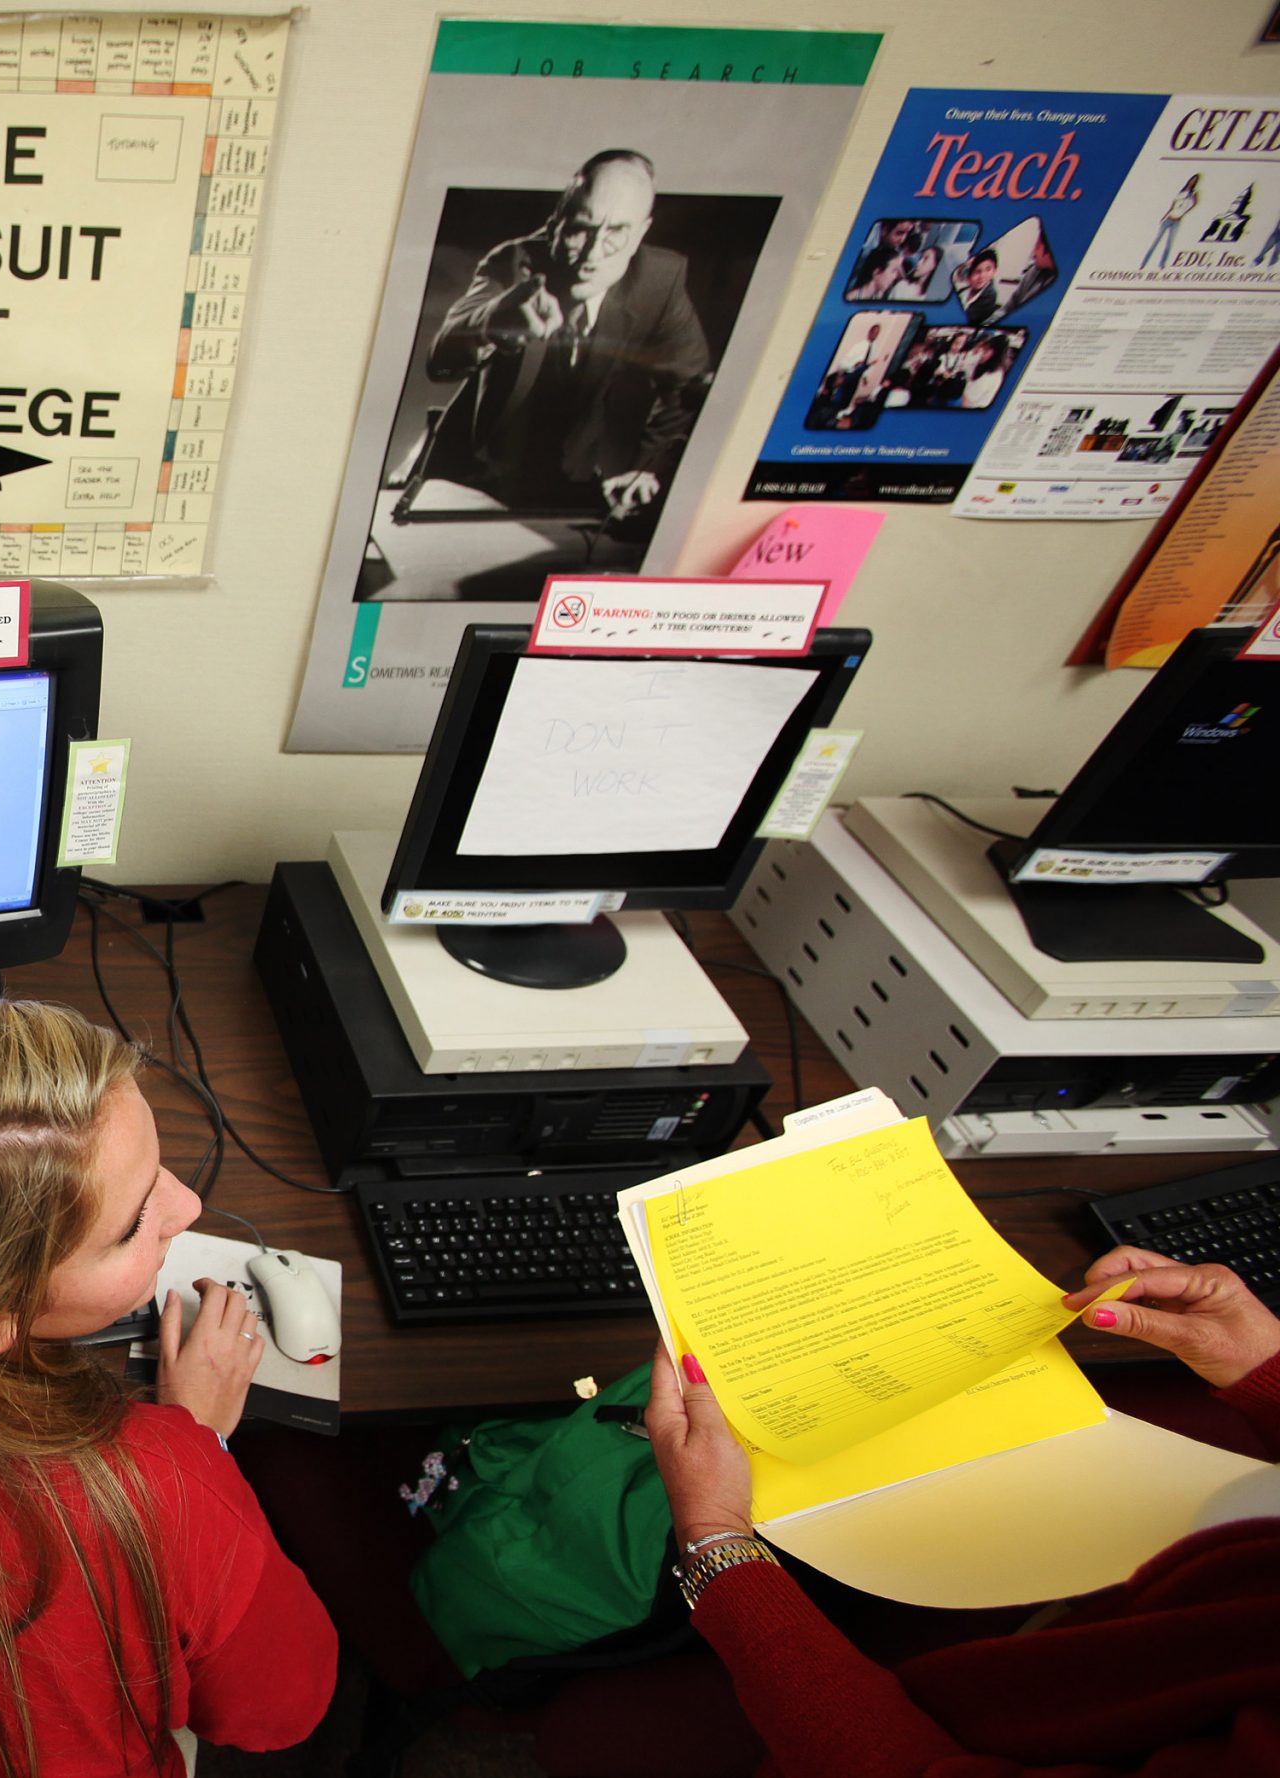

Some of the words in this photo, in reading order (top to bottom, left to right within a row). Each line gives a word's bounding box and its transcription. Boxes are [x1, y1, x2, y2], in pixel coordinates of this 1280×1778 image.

[510, 57, 585, 78] JOB
[629, 60, 799, 84] SEARCH
[945, 107, 983, 123] Change
[984, 108, 1009, 121] their
[1009, 109, 1034, 122] lives.
[1036, 109, 1076, 125] Change
[1075, 112, 1108, 125] yours.
[1169, 106, 1251, 152] GET
[914, 130, 1084, 201] Teach.
[1215, 251, 1247, 267] Inc.
[1144, 271, 1183, 282] BLACK
[1183, 271, 1237, 282] COLLEGE
[790, 444, 833, 456] California
[833, 446, 861, 456] Center
[743, 534, 815, 570] New
[592, 607, 653, 619] WARNING:
[672, 612, 701, 620] FOOD
[719, 613, 757, 622] DRINKS
[758, 614, 806, 623] ALLOWED
[650, 623, 664, 631] AT
[667, 623, 687, 632] THE
[689, 624, 753, 633] COMPUTERS!
[1182, 727, 1239, 738] Windows
[570, 769, 662, 799] WORK
